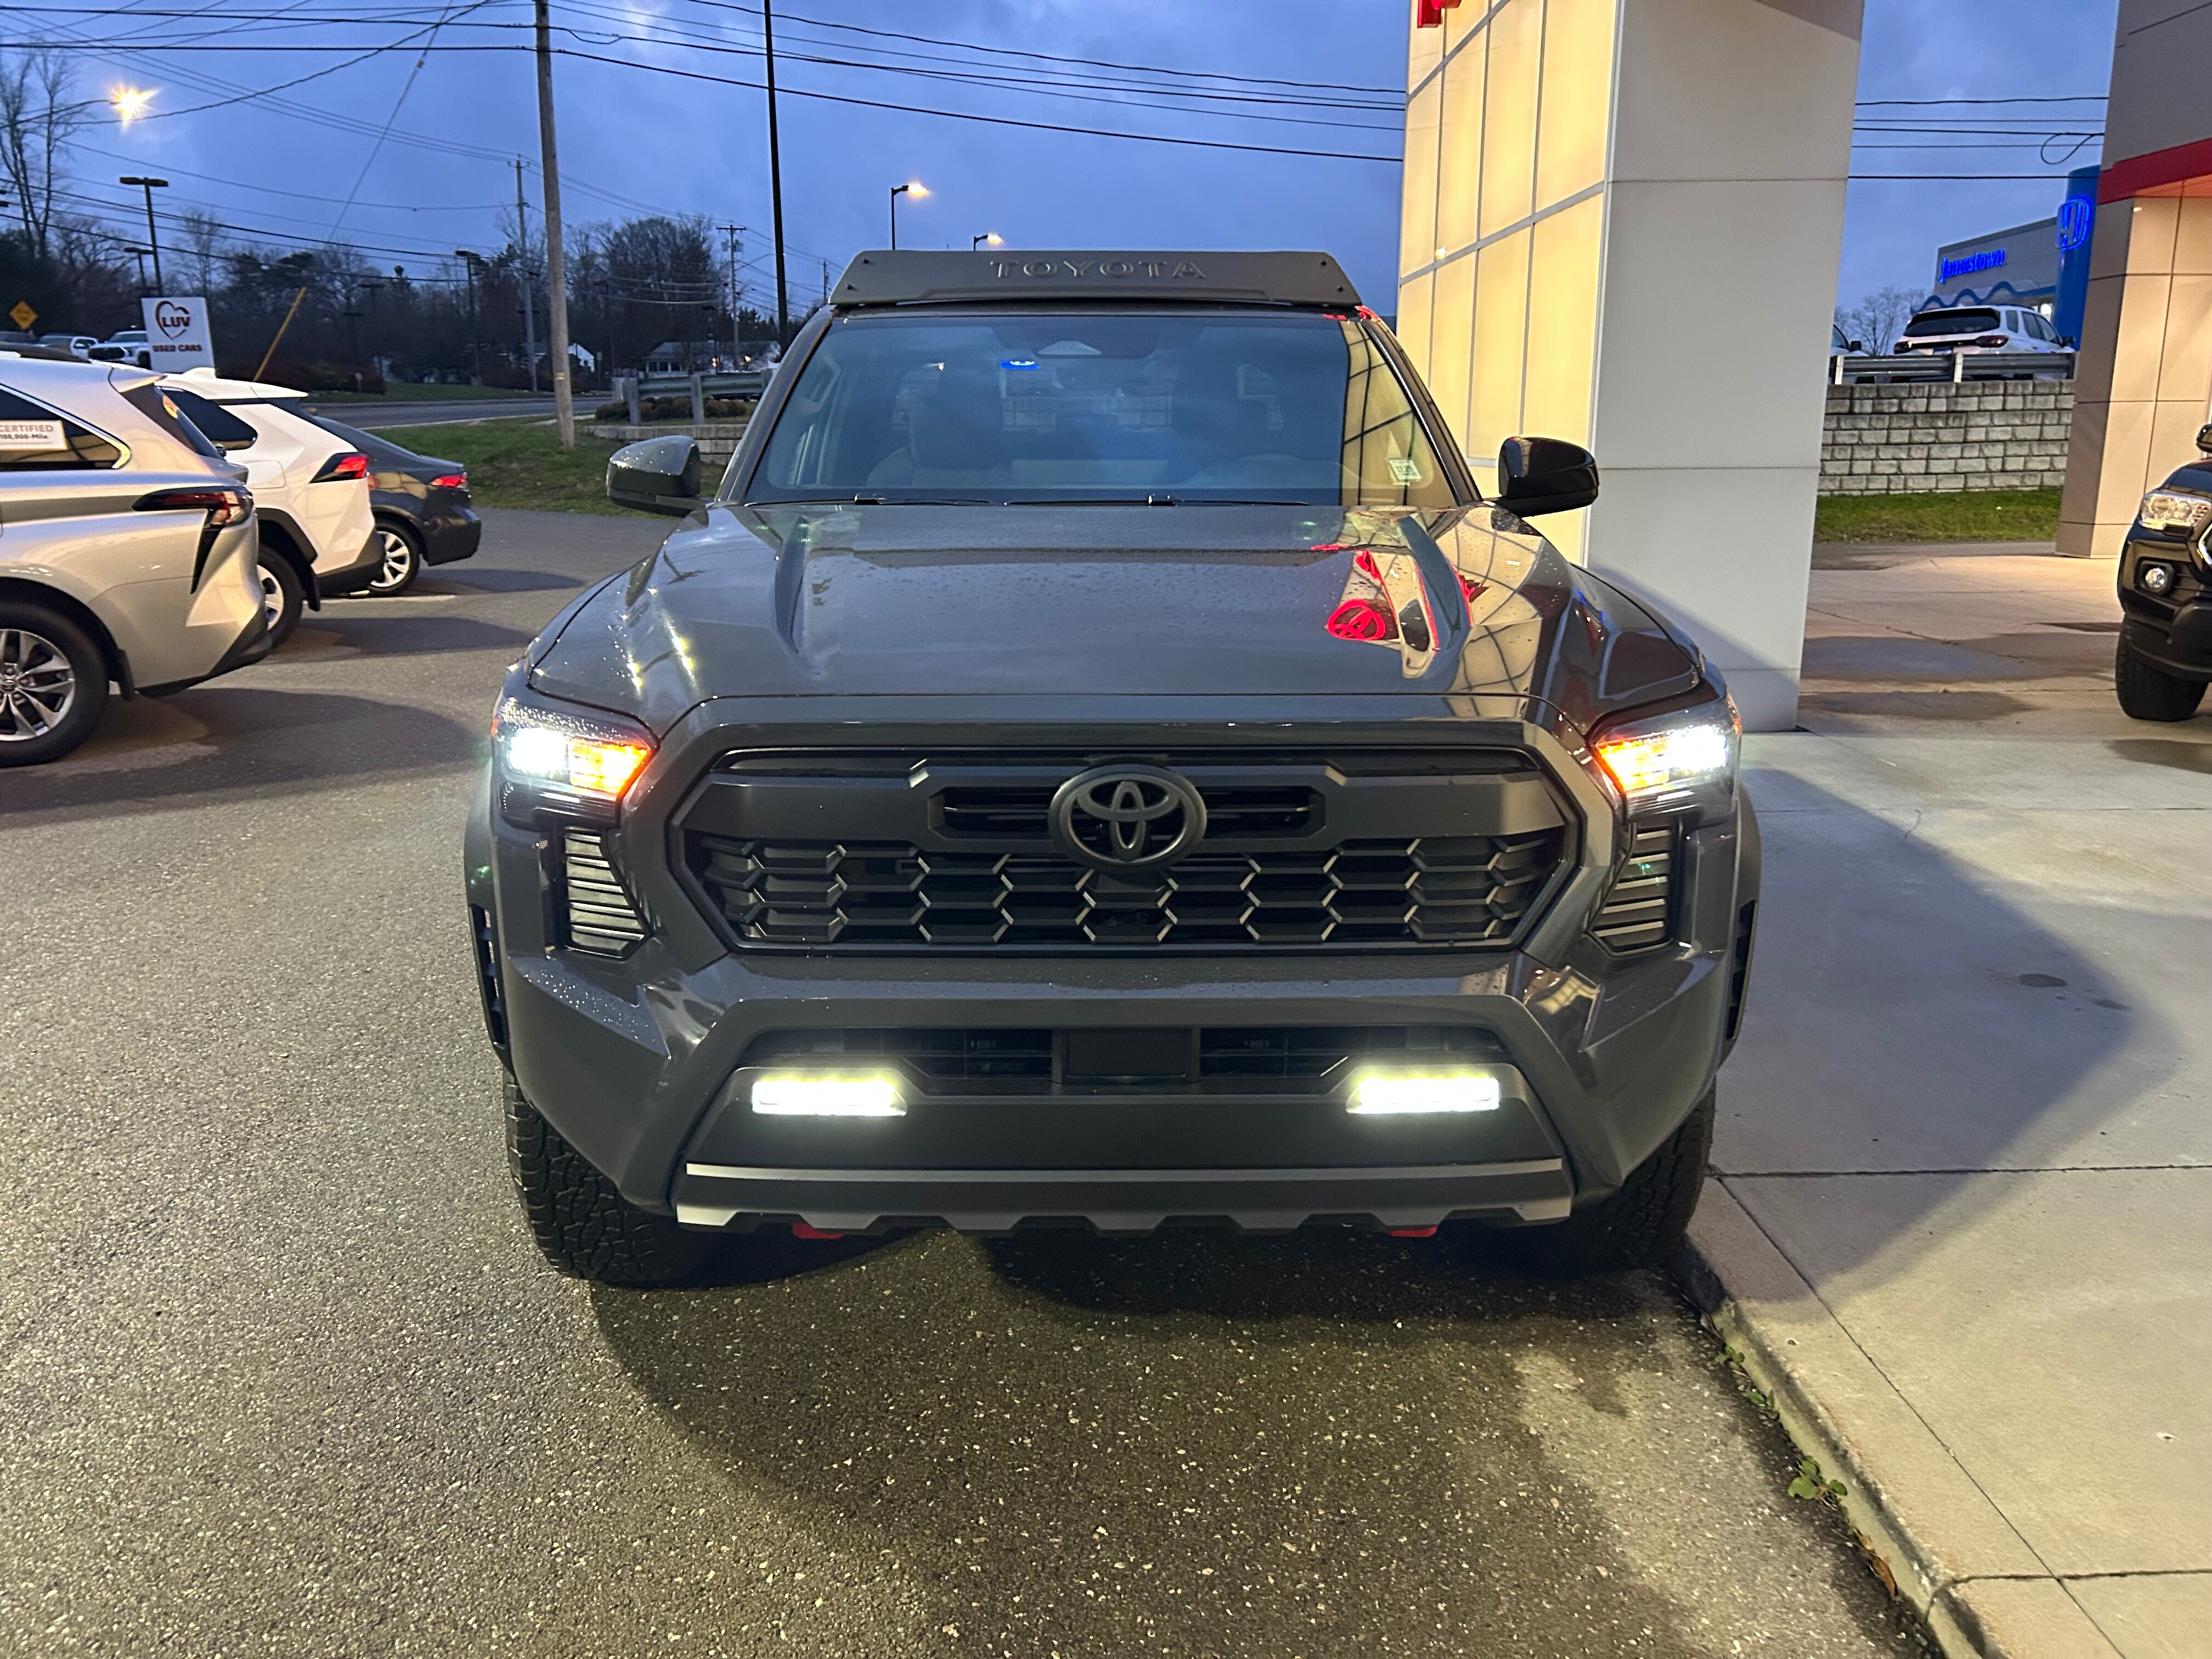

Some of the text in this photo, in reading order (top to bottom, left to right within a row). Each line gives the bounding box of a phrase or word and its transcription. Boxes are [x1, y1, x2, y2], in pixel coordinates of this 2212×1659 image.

[990, 261, 1206, 278] TOYOTA
[1939, 249, 2005, 284] Jamestown
[161, 317, 190, 327] LUV
